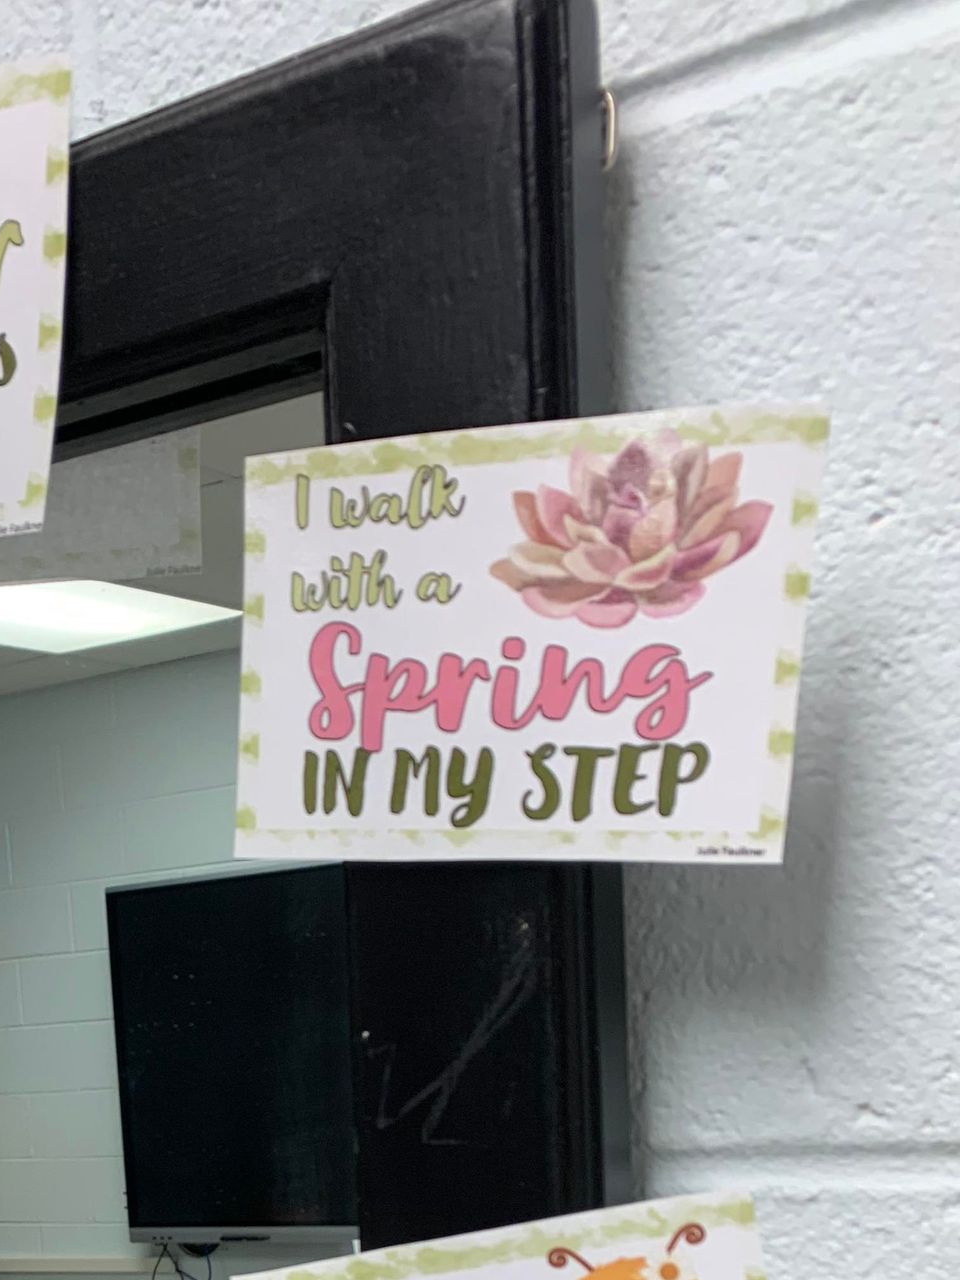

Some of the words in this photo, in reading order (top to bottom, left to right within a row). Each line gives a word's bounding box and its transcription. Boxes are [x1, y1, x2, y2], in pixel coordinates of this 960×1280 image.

[294, 473, 311, 530] I
[329, 464, 466, 530] walk
[291, 550, 402, 613] with
[416, 569, 461, 604] a
[308, 621, 714, 752] Spring
[303, 748, 370, 817] IN
[521, 742, 711, 822] STEP
